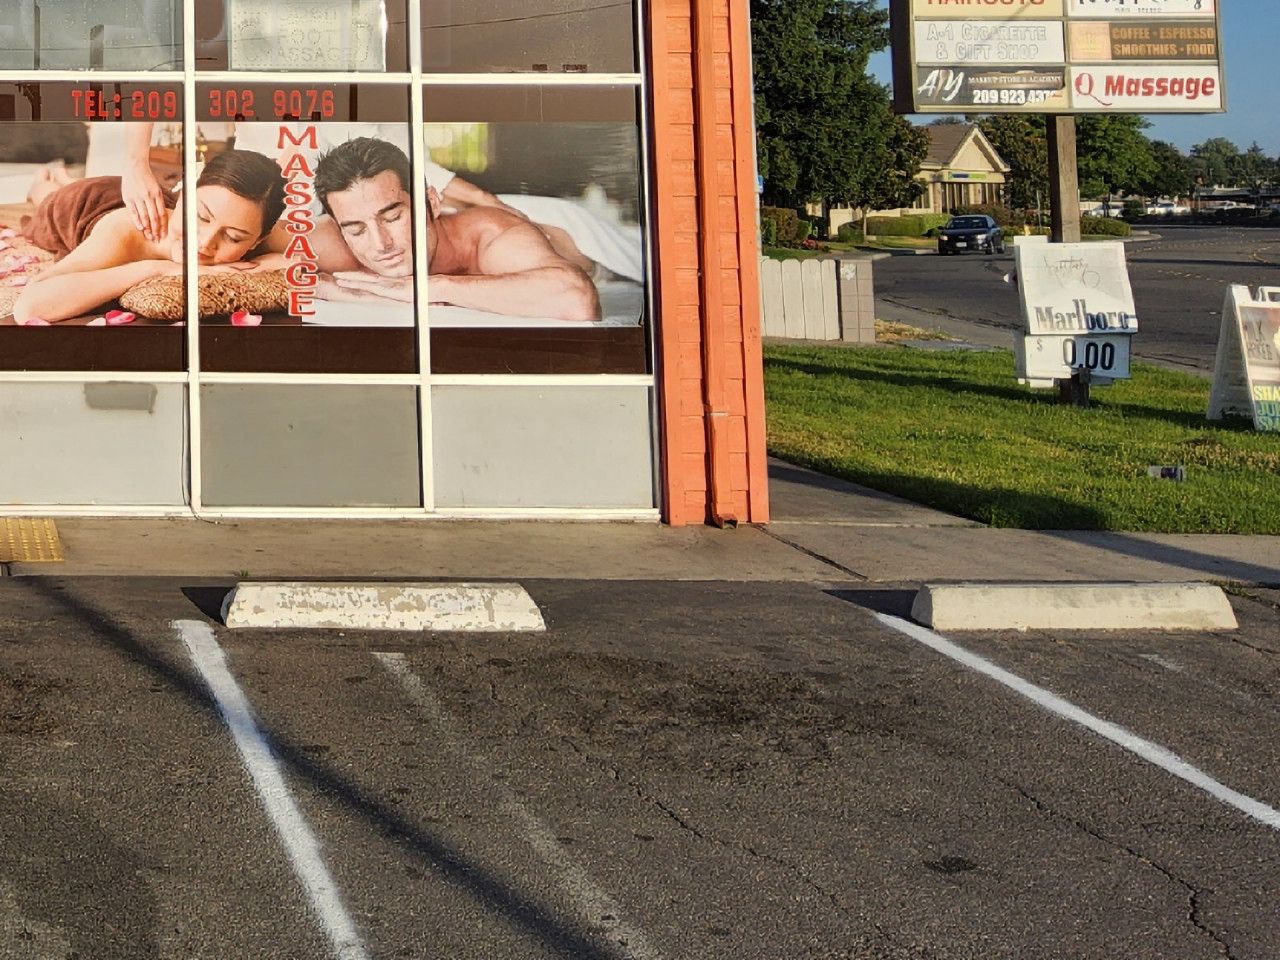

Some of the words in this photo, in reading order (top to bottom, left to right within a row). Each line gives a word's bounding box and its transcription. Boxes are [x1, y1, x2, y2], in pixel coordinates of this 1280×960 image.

[927, 23, 954, 40] A-1
[961, 23, 1048, 41] CIGARETTE
[1112, 27, 1150, 39] COFFEE
[1159, 27, 1216, 39] ESPRESSO
[956, 42, 992, 60] GIFT
[997, 42, 1039, 60] SHOP
[1113, 43, 1178, 55] SMOOTHIES
[1186, 43, 1216, 55] FOOD
[973, 89, 999, 104] 209
[1000, 89, 1026, 104] 923
[1074, 72, 1112, 106] Q
[1104, 75, 1215, 100] Massage
[131, 90, 177, 118] 209
[208, 89, 255, 117] 302
[272, 89, 335, 118] 9076
[276, 124, 320, 318] MASSAGE
[1034, 298, 1130, 331] Marlboro
[1062, 338, 1115, 371] 0.00
